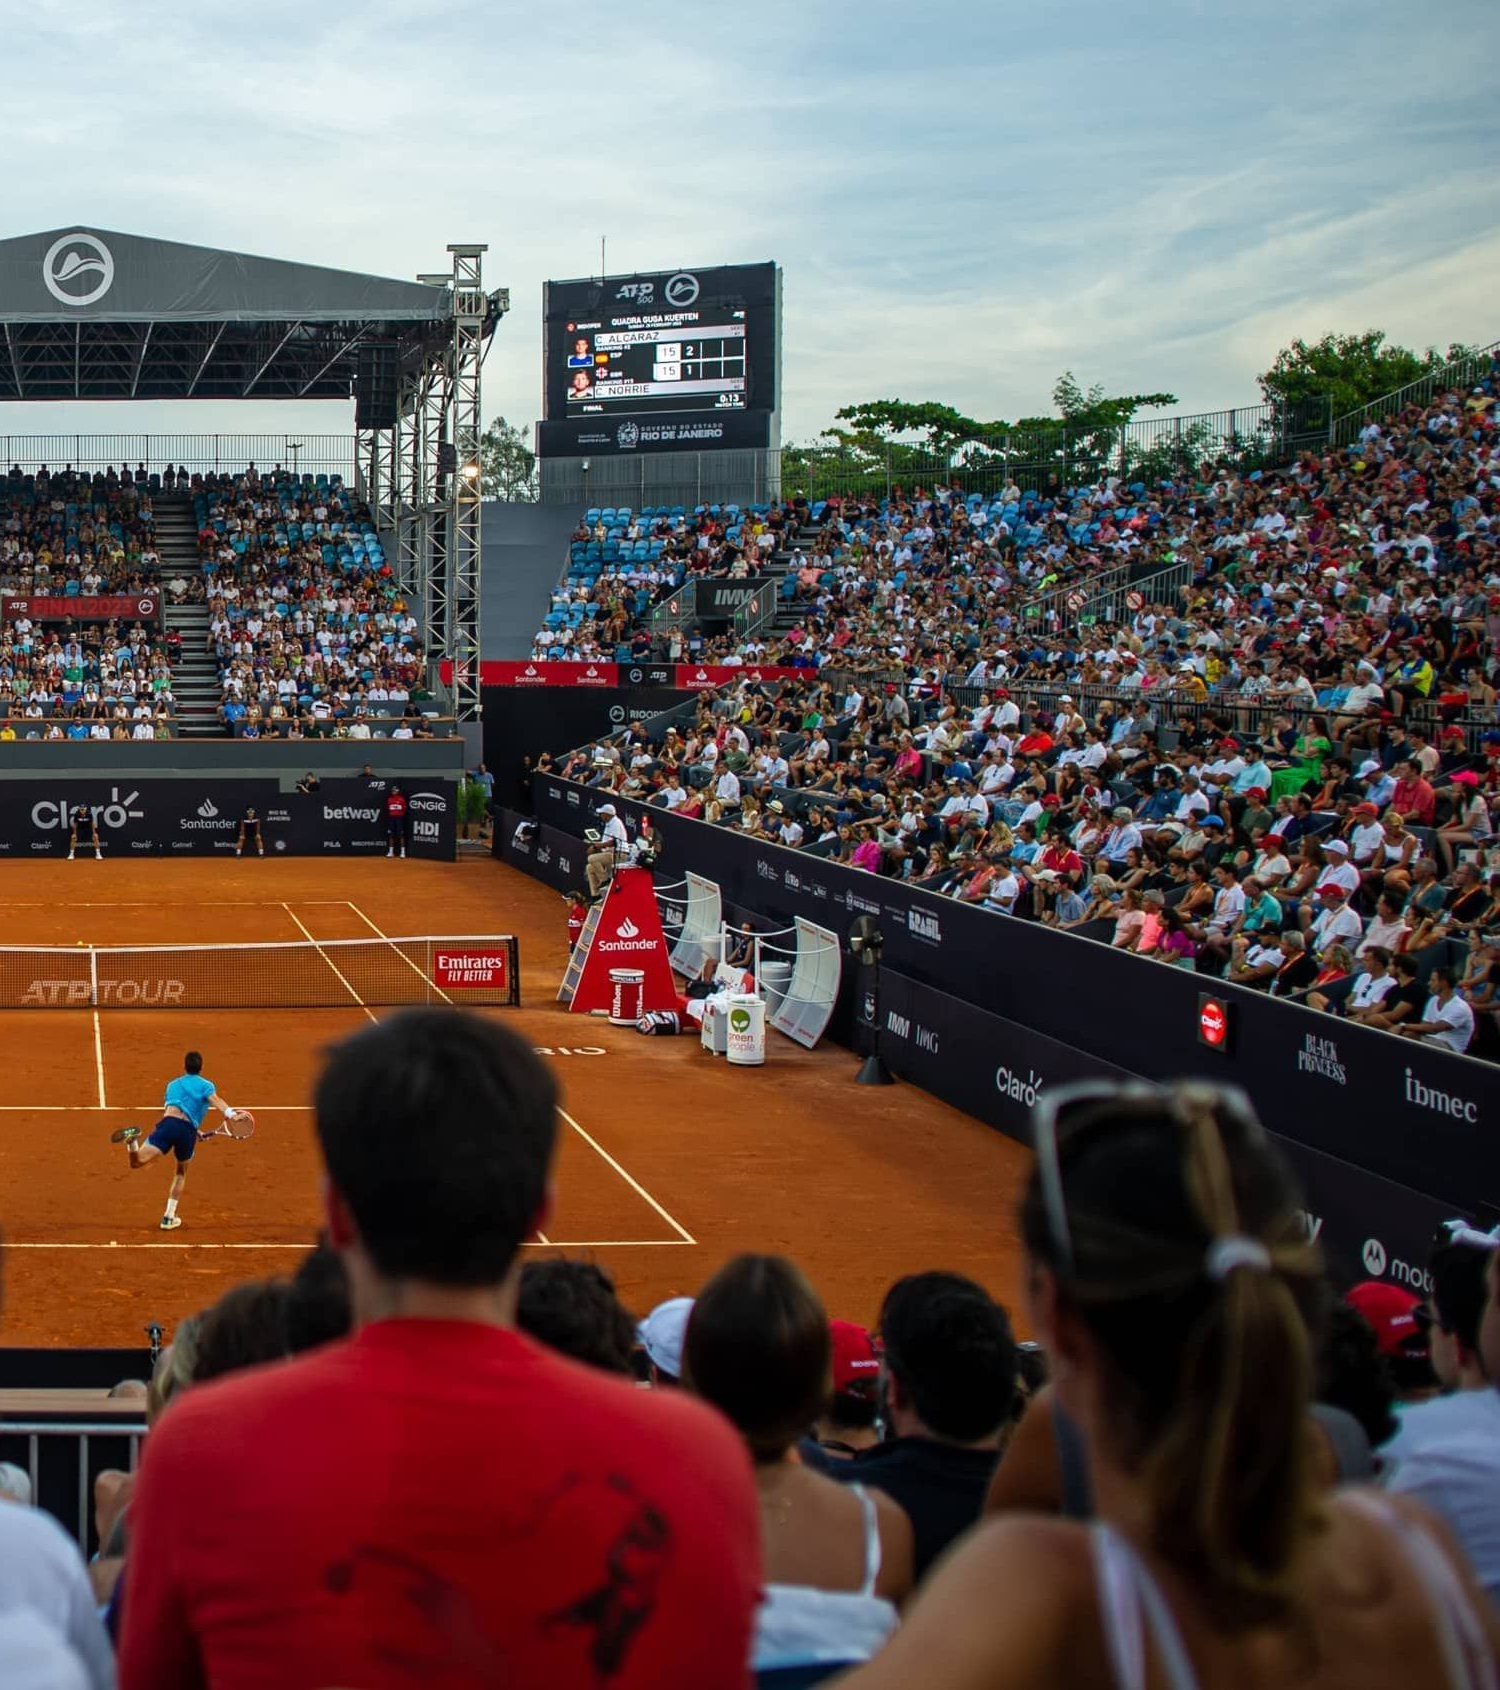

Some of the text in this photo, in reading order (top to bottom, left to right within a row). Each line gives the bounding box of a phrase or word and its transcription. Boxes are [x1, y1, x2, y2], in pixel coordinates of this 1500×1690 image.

[616, 282, 654, 299] ATP
[664, 313, 699, 321] KUERTEN
[609, 332, 660, 343] ALCARAZ
[663, 347, 676, 357] 15
[686, 346, 694, 356] 2
[663, 366, 676, 376] 15
[686, 365, 692, 375] 1
[608, 385, 650, 395] NORRIE
[641, 428, 723, 441] RIO DE JANEIRO
[33, 599, 133, 616] FINAL 2023
[324, 806, 381, 822] betway
[180, 819, 236, 830] Santander
[414, 821, 440, 836] HDI
[598, 940, 658, 952] Santander
[438, 955, 502, 969] Emirates
[448, 970, 493, 982] FLY BETTER
[20, 980, 186, 1004] ATP TOUR
[612, 984, 621, 1017] Wilson
[887, 1011, 911, 1039] IMM
[1306, 1034, 1338, 1062] BLACK
[996, 1066, 1040, 1107] Claro
[1405, 1067, 1477, 1123] ibmec
